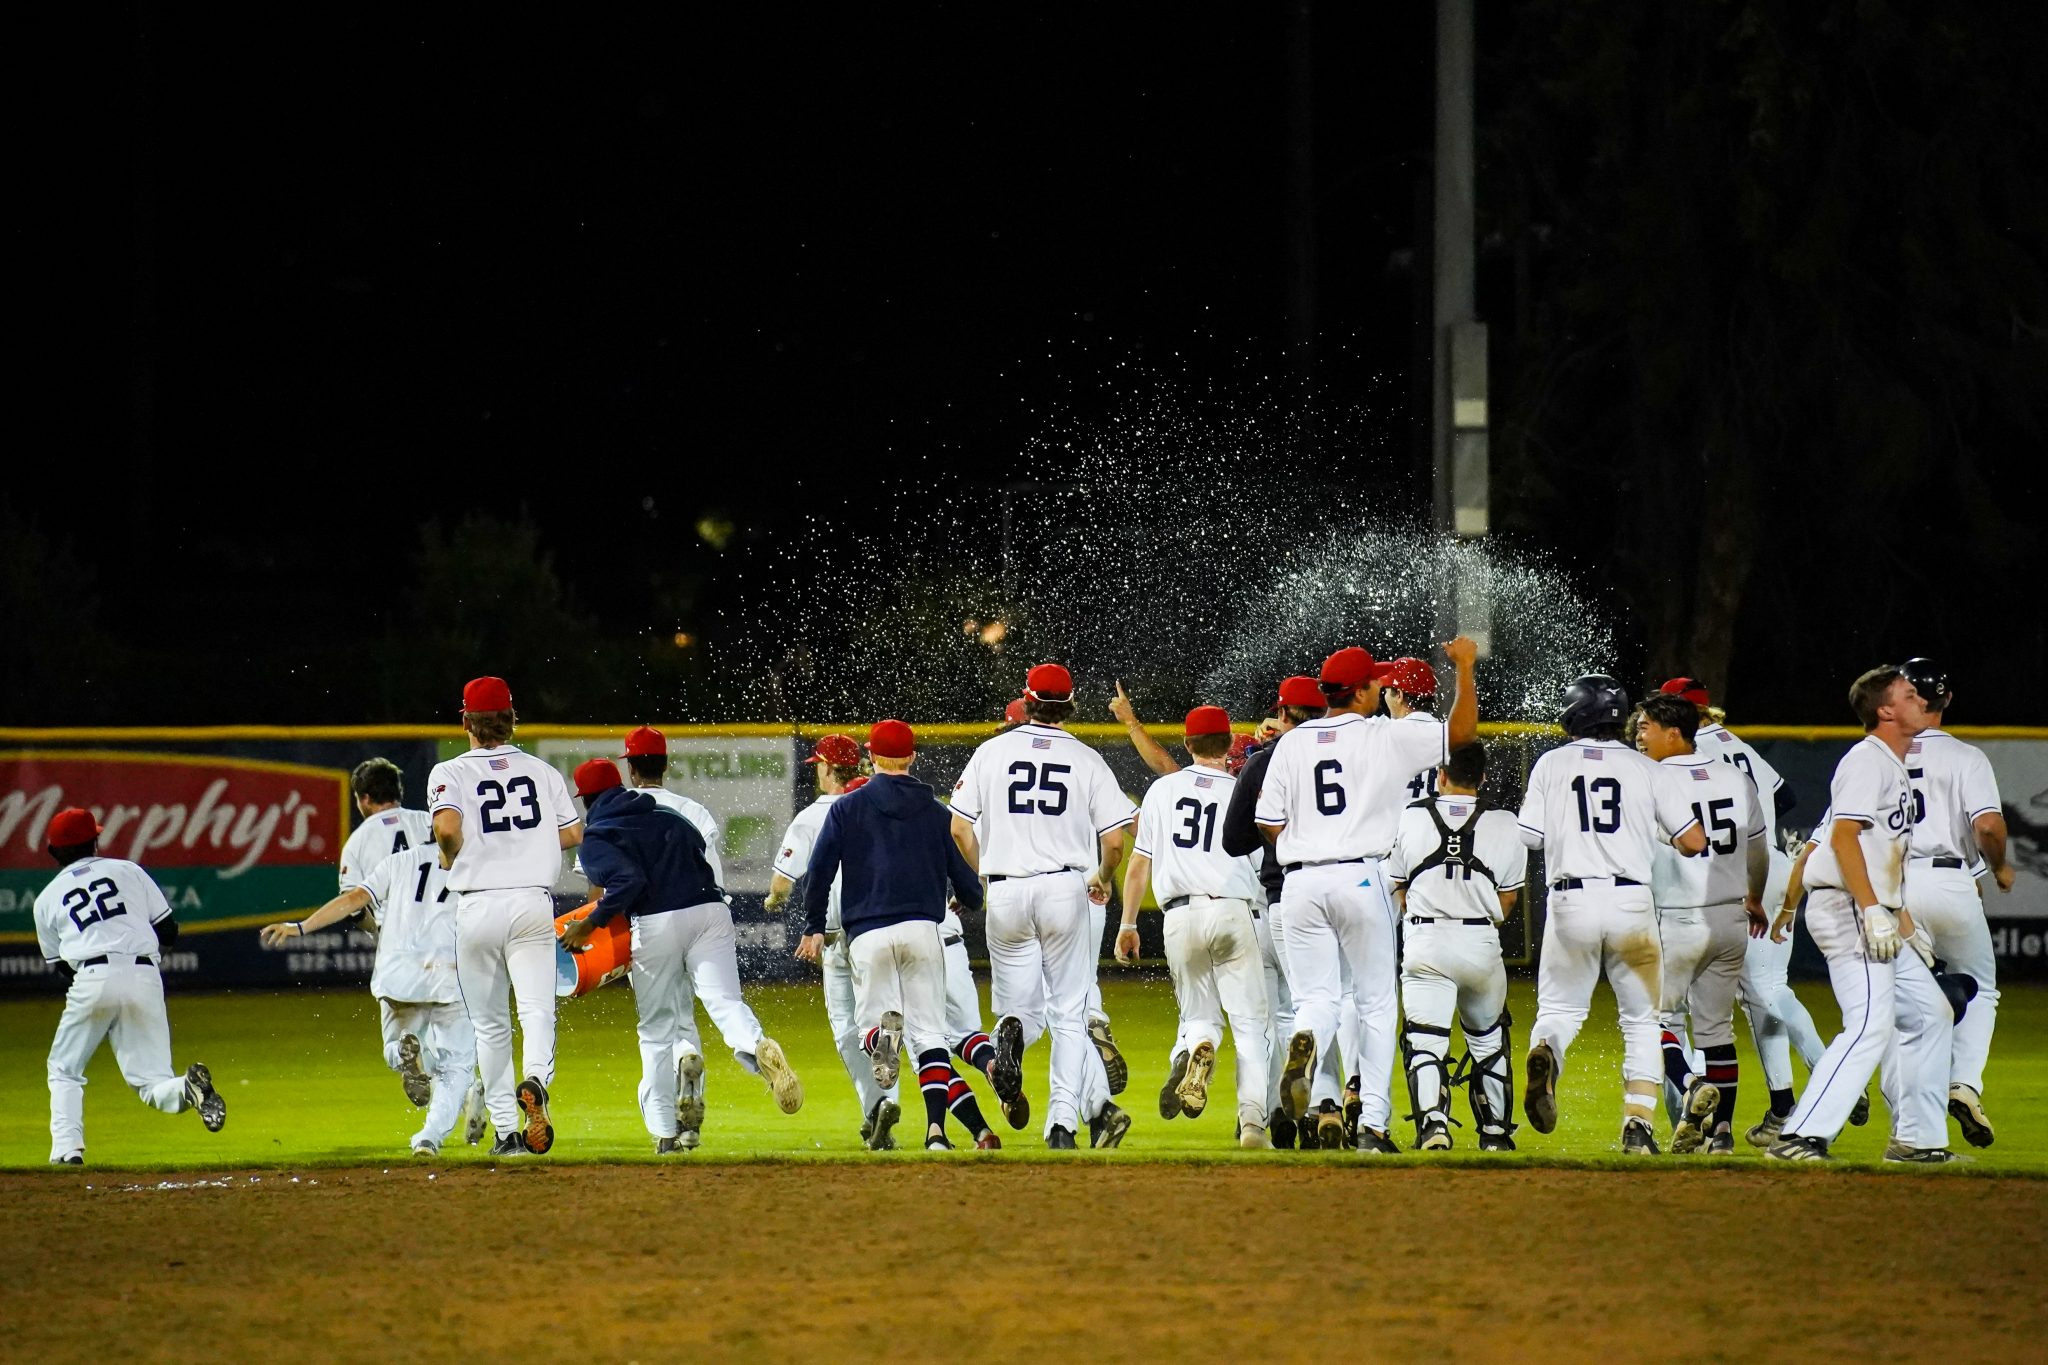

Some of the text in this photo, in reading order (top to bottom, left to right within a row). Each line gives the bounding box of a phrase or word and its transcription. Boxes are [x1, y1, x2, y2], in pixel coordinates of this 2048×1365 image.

[477, 776, 542, 833] 23
[1008, 761, 1071, 816] 25
[1314, 759, 1347, 816] 6
[1571, 775, 1621, 834] 13
[0, 779, 317, 880] Mrphy's
[1172, 797, 1218, 852] 31
[62, 877, 127, 932] 22
[415, 862, 450, 903] 1
